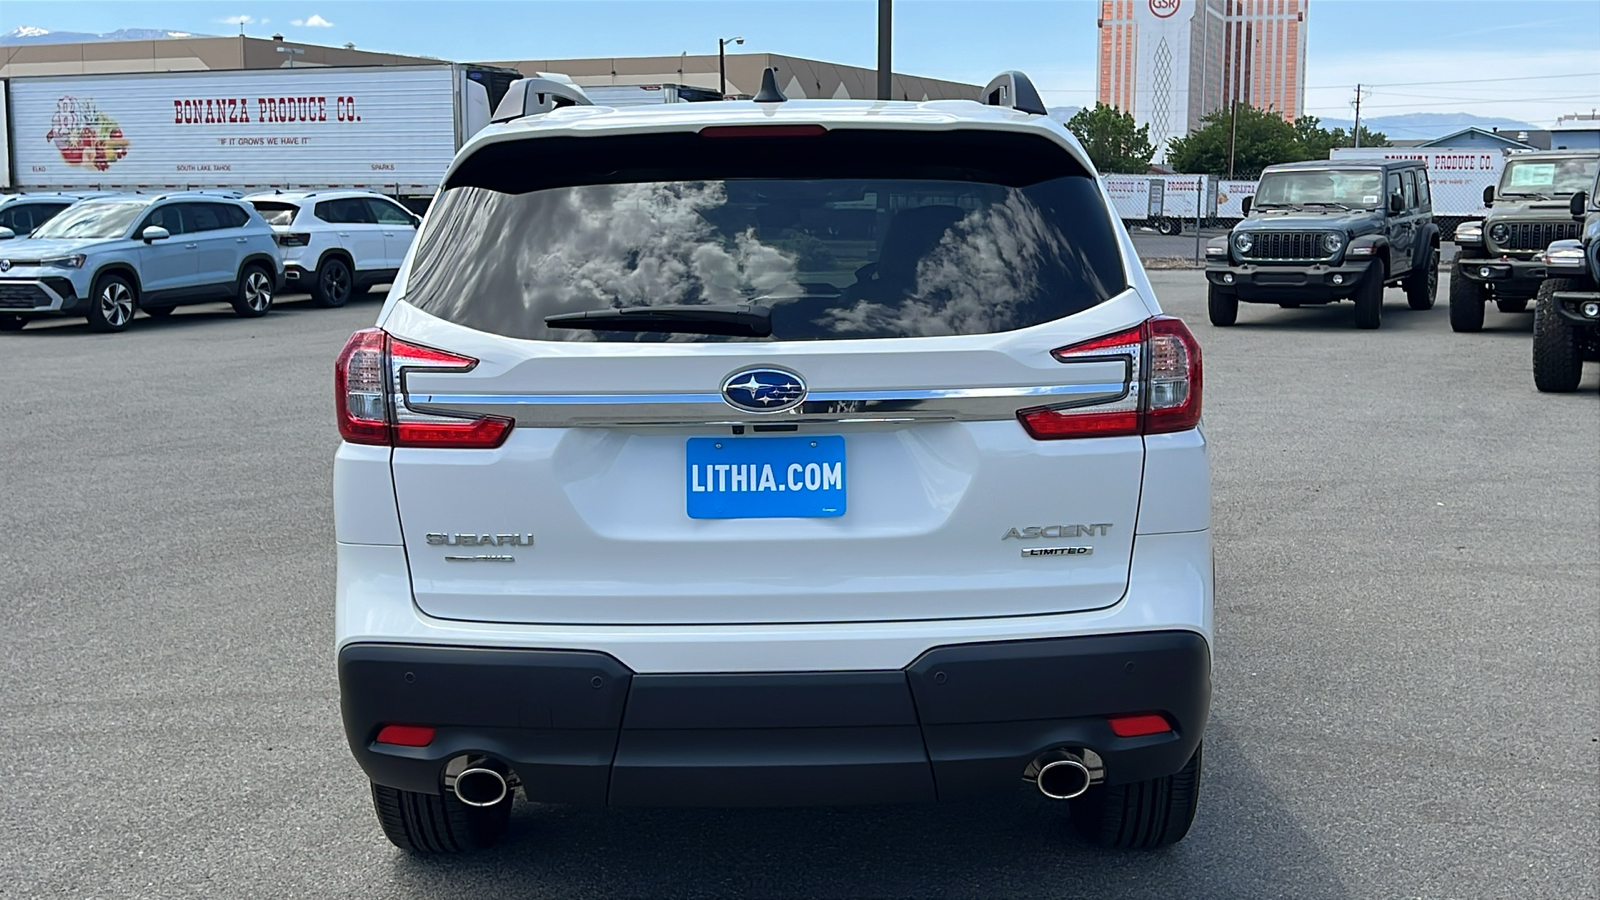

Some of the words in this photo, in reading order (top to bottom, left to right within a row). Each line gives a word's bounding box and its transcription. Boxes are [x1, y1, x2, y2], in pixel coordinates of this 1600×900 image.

[174, 98, 250, 124] BONANZA
[258, 96, 327, 122] PRODUCE
[337, 96, 361, 122] CO.
[238, 137, 265, 146] GROWS
[267, 137, 279, 145] WE
[281, 137, 299, 145] HAVE
[1435, 155, 1475, 170] PRODUCE
[1480, 155, 1494, 170] CO.
[692, 462, 842, 492] LITHIA.COM
[1001, 523, 1113, 540] ASCENT
[426, 533, 534, 546] SUBARU
[1030, 547, 1088, 556] LIMITED
